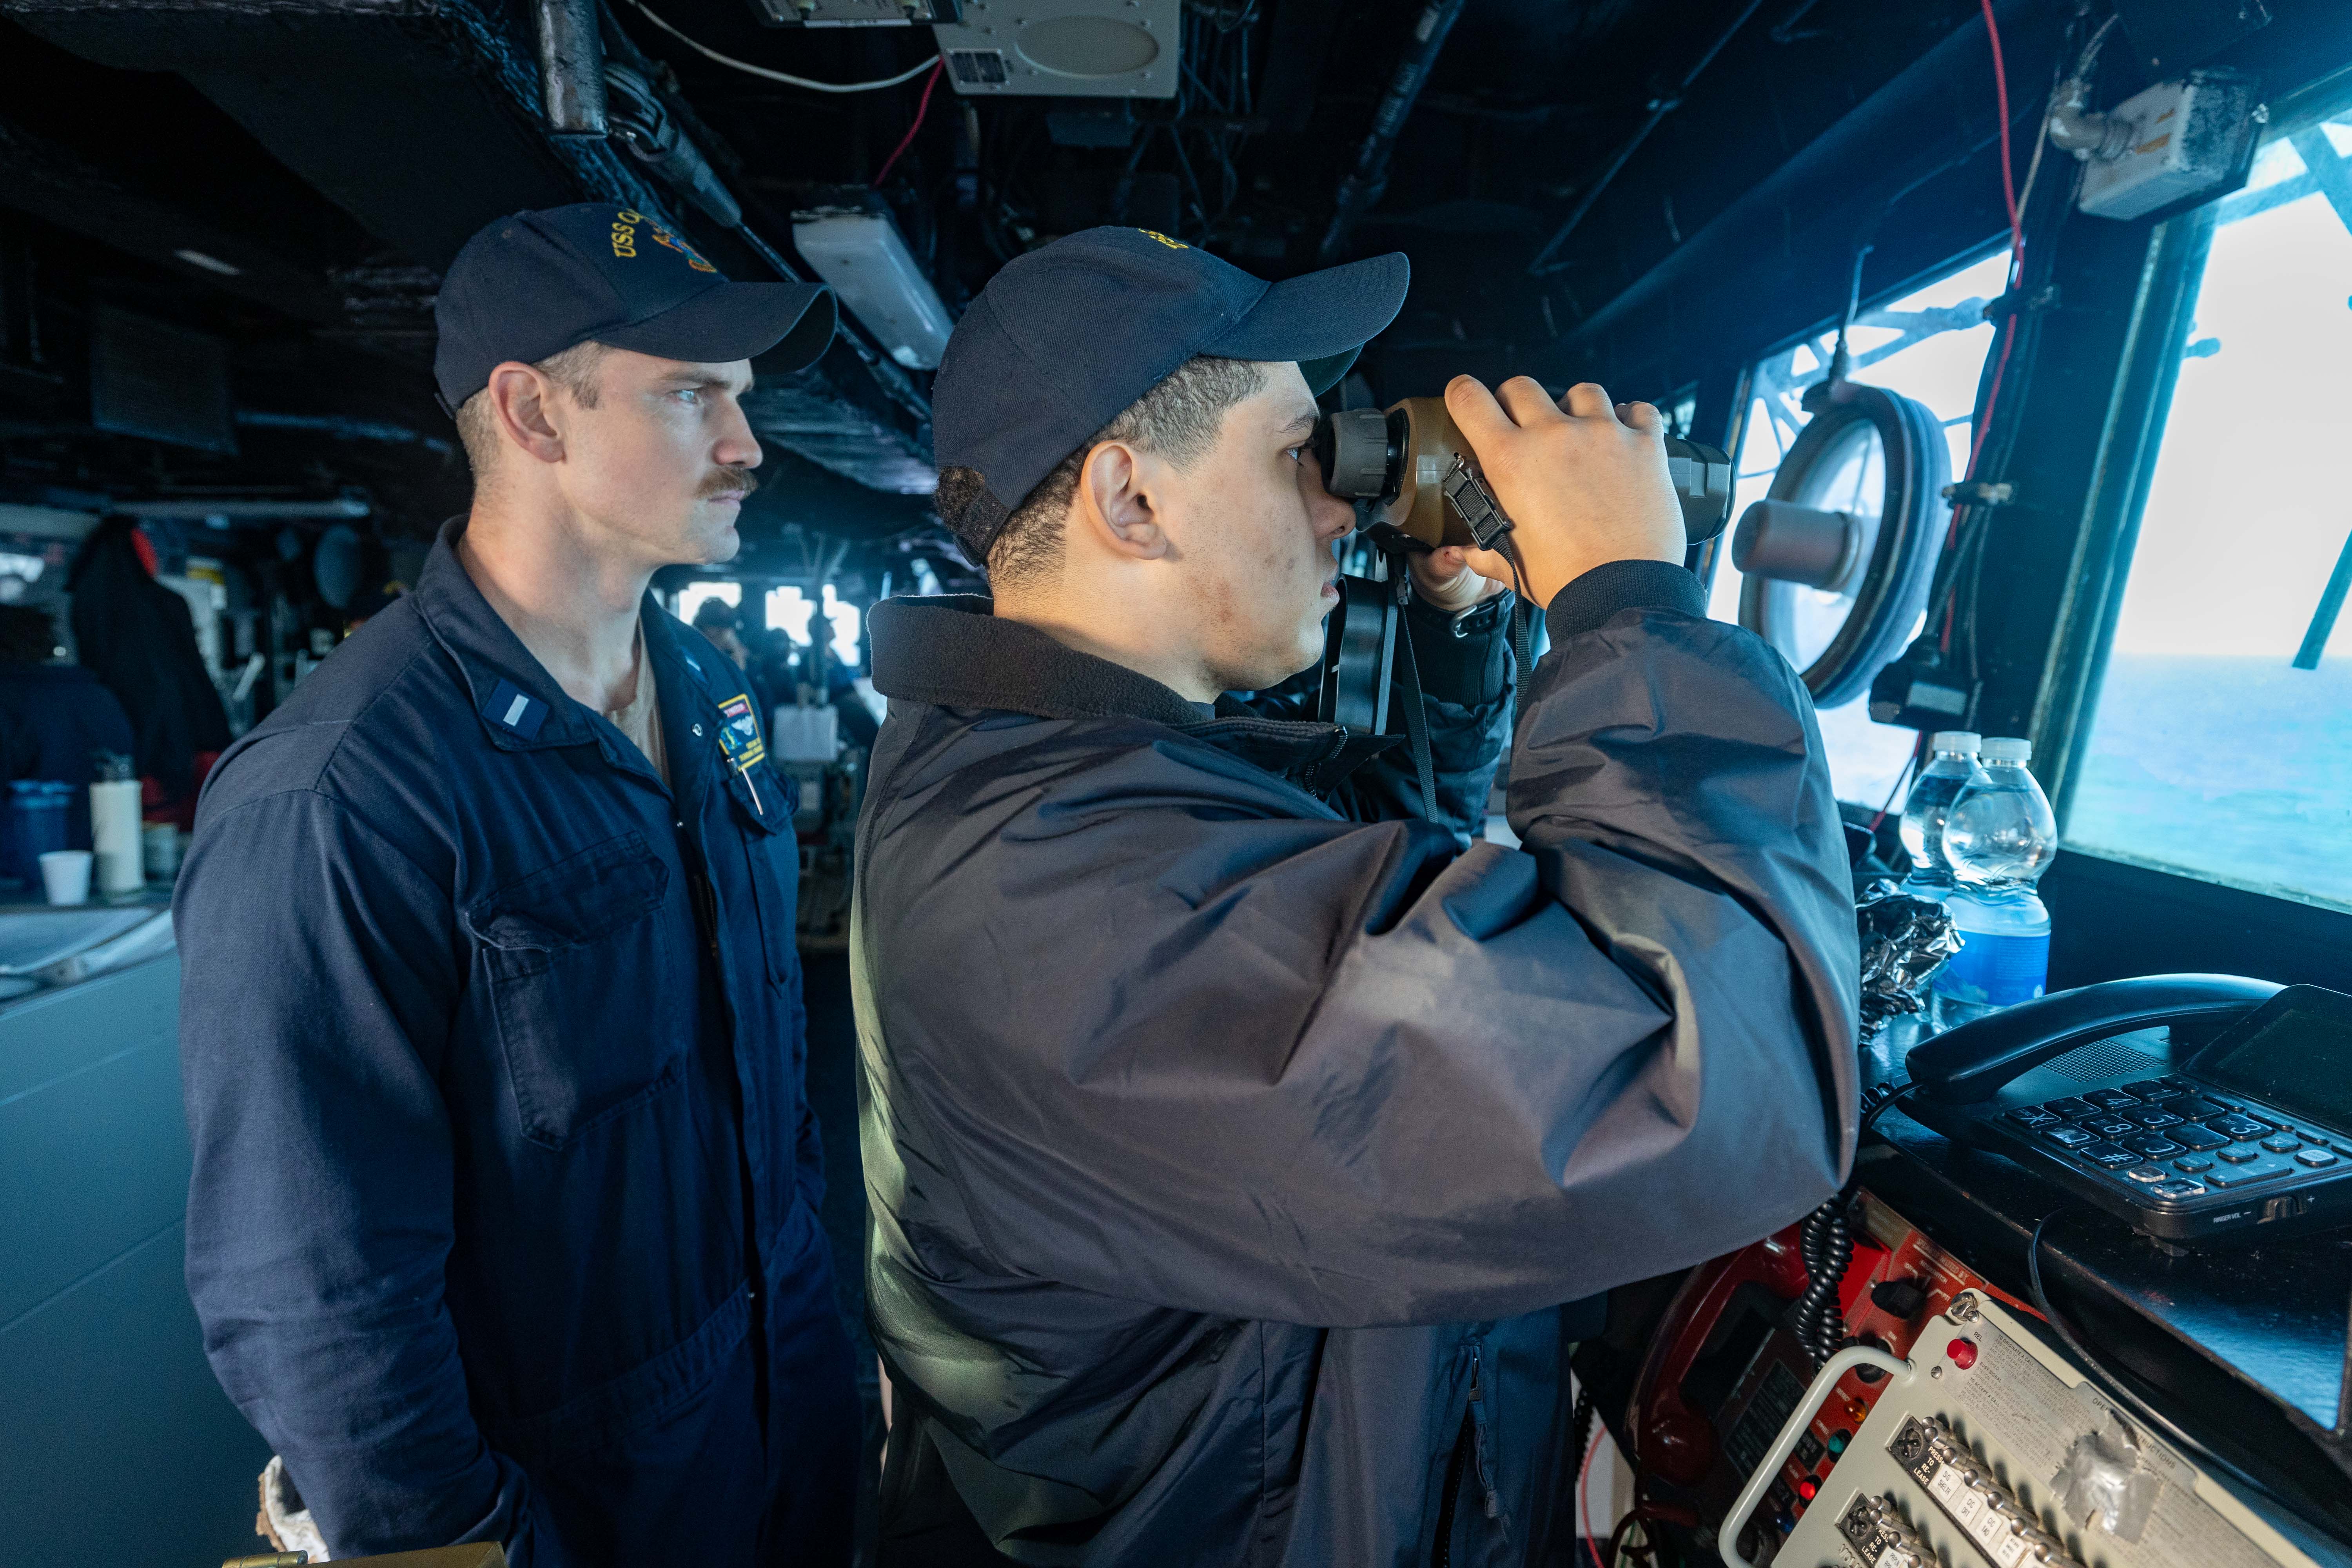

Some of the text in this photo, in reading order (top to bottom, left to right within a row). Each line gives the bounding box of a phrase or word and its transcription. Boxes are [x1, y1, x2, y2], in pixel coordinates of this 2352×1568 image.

[611, 222, 637, 257] USS
[2099, 1095, 2134, 1105] 4
[2098, 1122, 2137, 1134] 8
[2224, 1123, 2267, 1134] 3
[1973, 1331, 1984, 1342] REL
[2002, 1339, 2021, 1356] ORIGINATE
[2024, 1357, 2034, 1367] CALL
[1980, 1362, 1989, 1371] BUSY
[1989, 1370, 2002, 1382] SIGNAL
[1974, 1382, 1988, 1395] ACCEPT
[1991, 1397, 2001, 1406] CALL
[1928, 1446, 1944, 1463] PRESS
[1926, 1457, 1935, 1466] TO
[1921, 1463, 1932, 1474] RE-
[1913, 1467, 1929, 1485] LEASE
[1942, 1470, 1951, 1481] SIG
[1937, 1479, 1951, 1495] SHELTR
[1966, 1498, 1975, 1508] CIC
[1987, 1517, 1996, 1528] CIC
[1874, 1536, 1882, 1545] TO
[1868, 1541, 1878, 1553] RE-
[1861, 1545, 1876, 1564] LEASE
